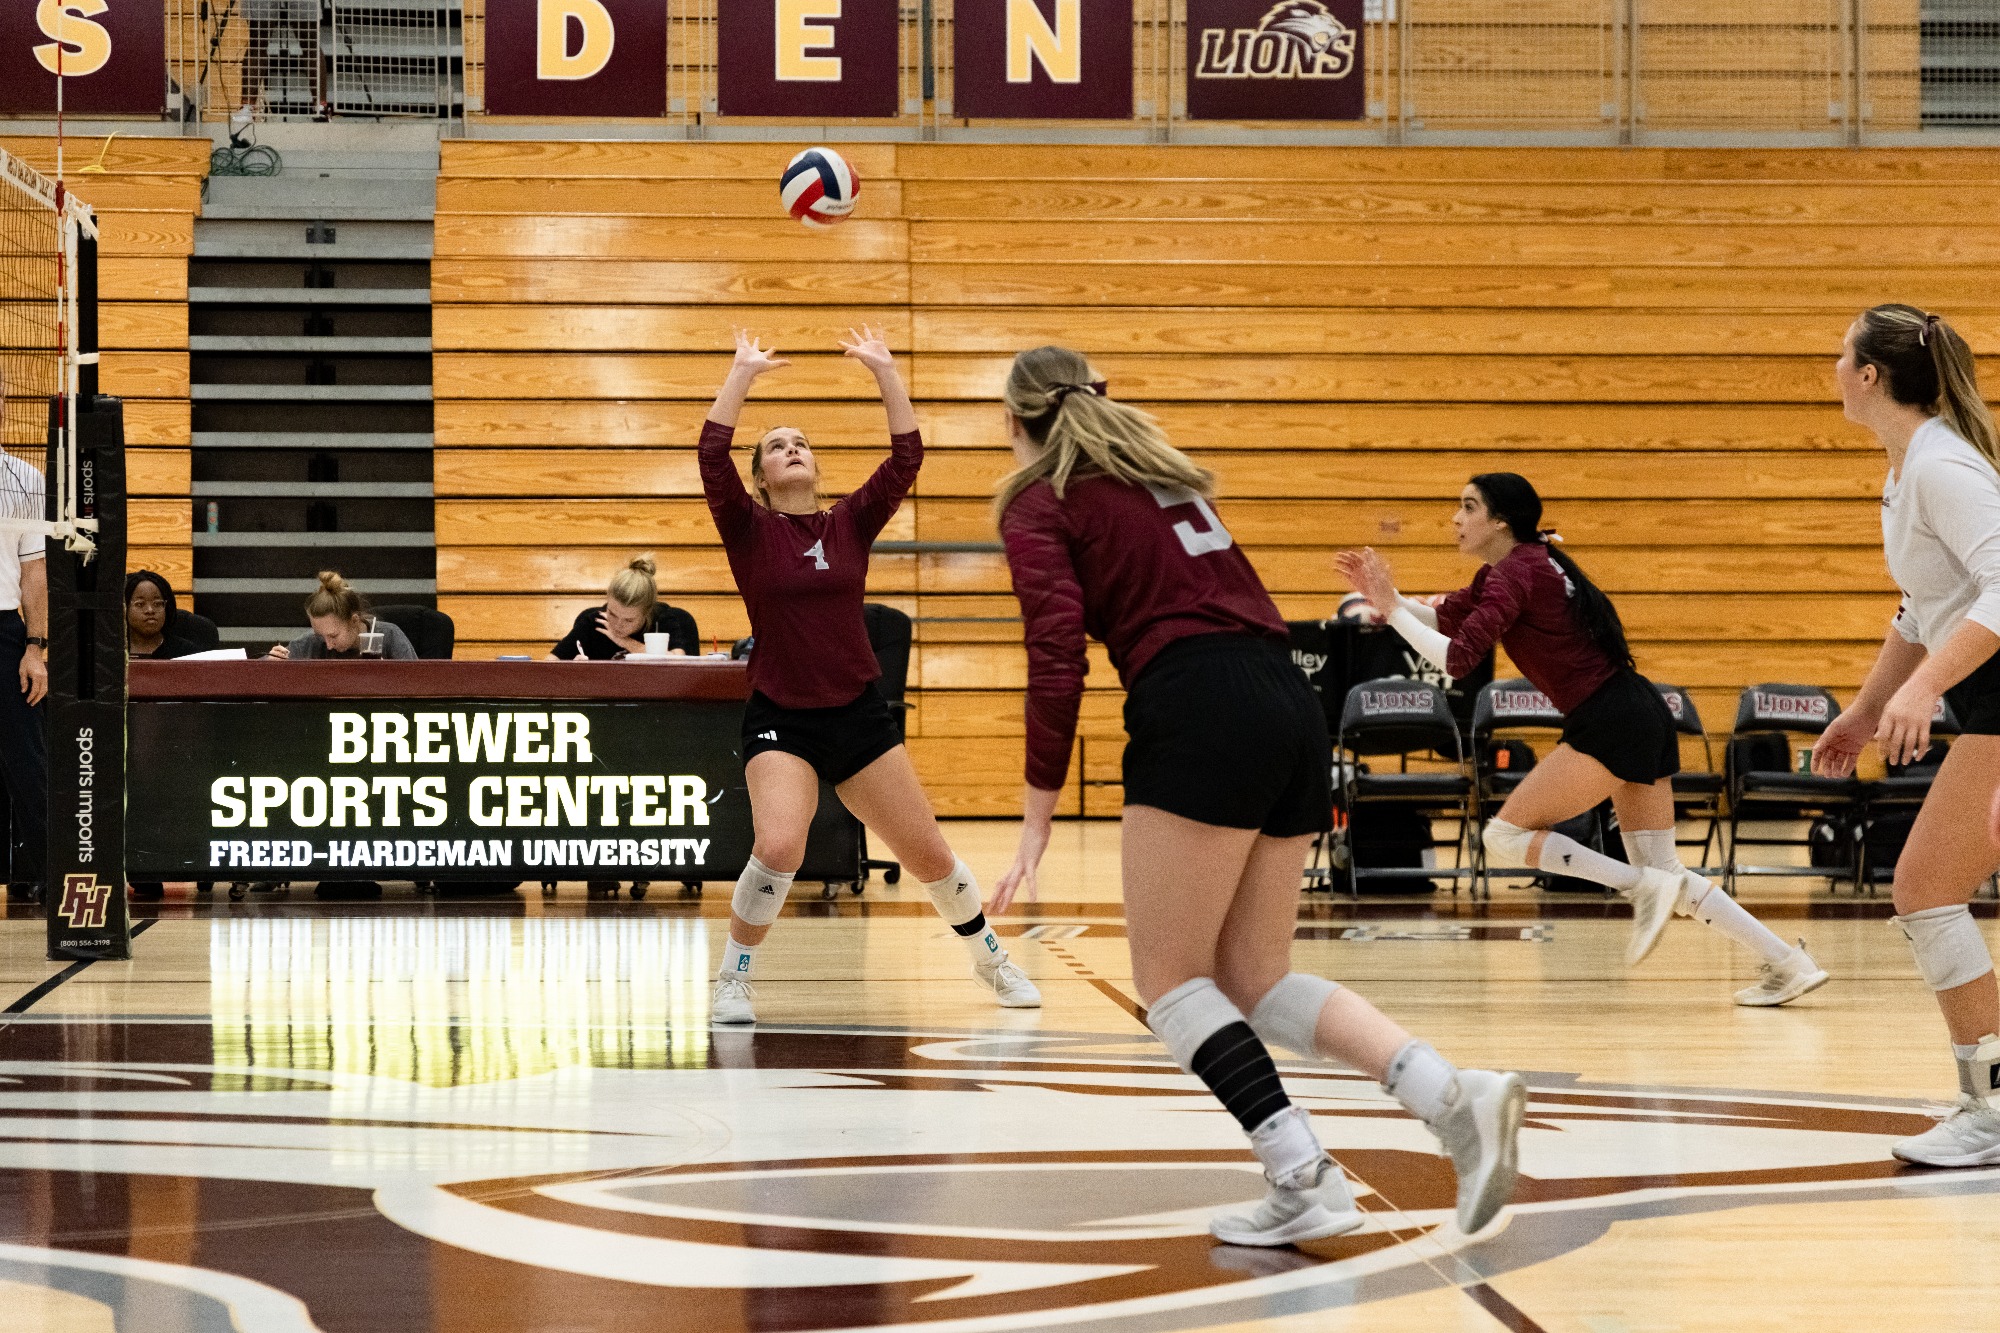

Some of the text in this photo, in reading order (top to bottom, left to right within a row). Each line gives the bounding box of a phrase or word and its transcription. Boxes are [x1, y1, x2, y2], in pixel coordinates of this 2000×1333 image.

[32, 0, 112, 77] S
[536, 0, 615, 81] D
[1195, 29, 1356, 79] LIONS
[81, 460, 96, 505] sports
[1360, 689, 1434, 709] LIONS
[1490, 689, 1554, 710] LION
[1754, 691, 1829, 716] LIONS
[328, 712, 593, 764] BREWER
[75, 727, 96, 863] sports imports
[210, 775, 710, 828] SPORTS CENTER
[209, 838, 711, 867] FREED-HARDEMAN UNIVERSITY
[60, 940, 78, 948] (800)
